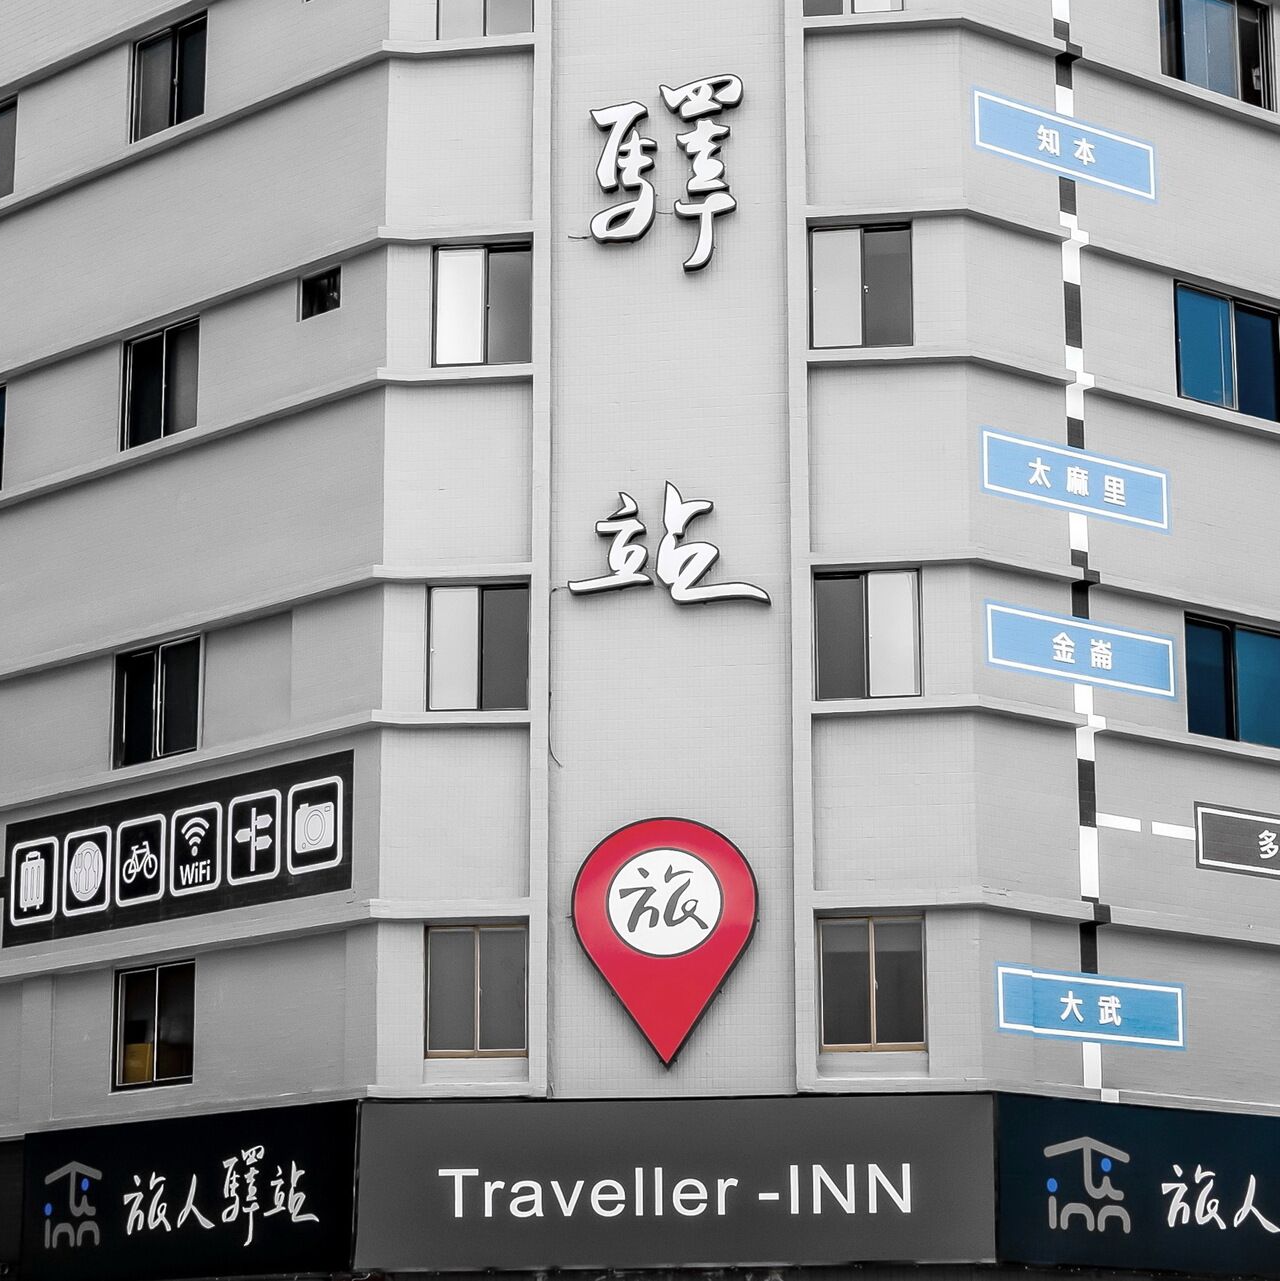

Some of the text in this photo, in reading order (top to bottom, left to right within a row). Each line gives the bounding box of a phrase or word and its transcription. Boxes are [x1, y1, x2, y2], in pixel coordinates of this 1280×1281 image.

[1037, 124, 1097, 165] 知本
[1028, 457, 1127, 507] 太麻里
[1052, 631, 1113, 671] 金崙
[179, 859, 212, 887] WiFi
[619, 866, 709, 933] 旅
[1059, 991, 1122, 1026] 大武
[123, 1145, 320, 1247] 旅人驛站
[437, 1164, 739, 1219] Traveller
